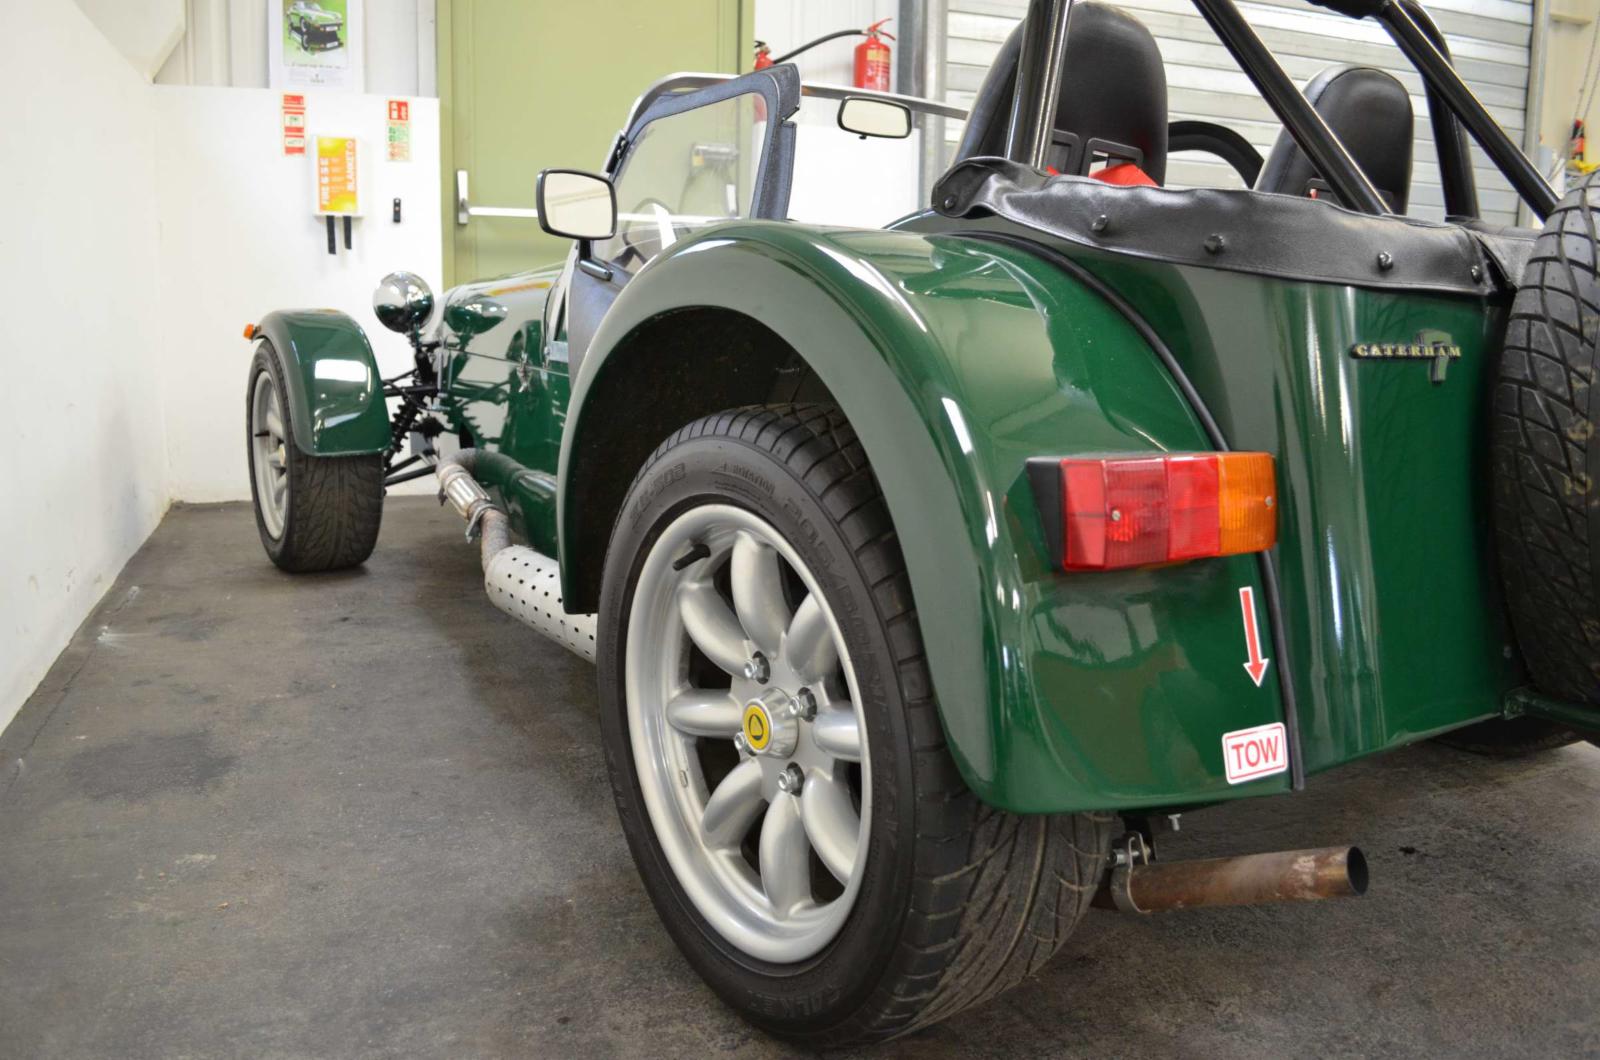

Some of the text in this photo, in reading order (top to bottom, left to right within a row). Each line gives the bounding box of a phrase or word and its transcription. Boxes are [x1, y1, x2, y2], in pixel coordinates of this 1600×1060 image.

[346, 149, 356, 192] BLANKET
[1354, 343, 1462, 359] CATERHAM
[1231, 735, 1279, 770] TOW
